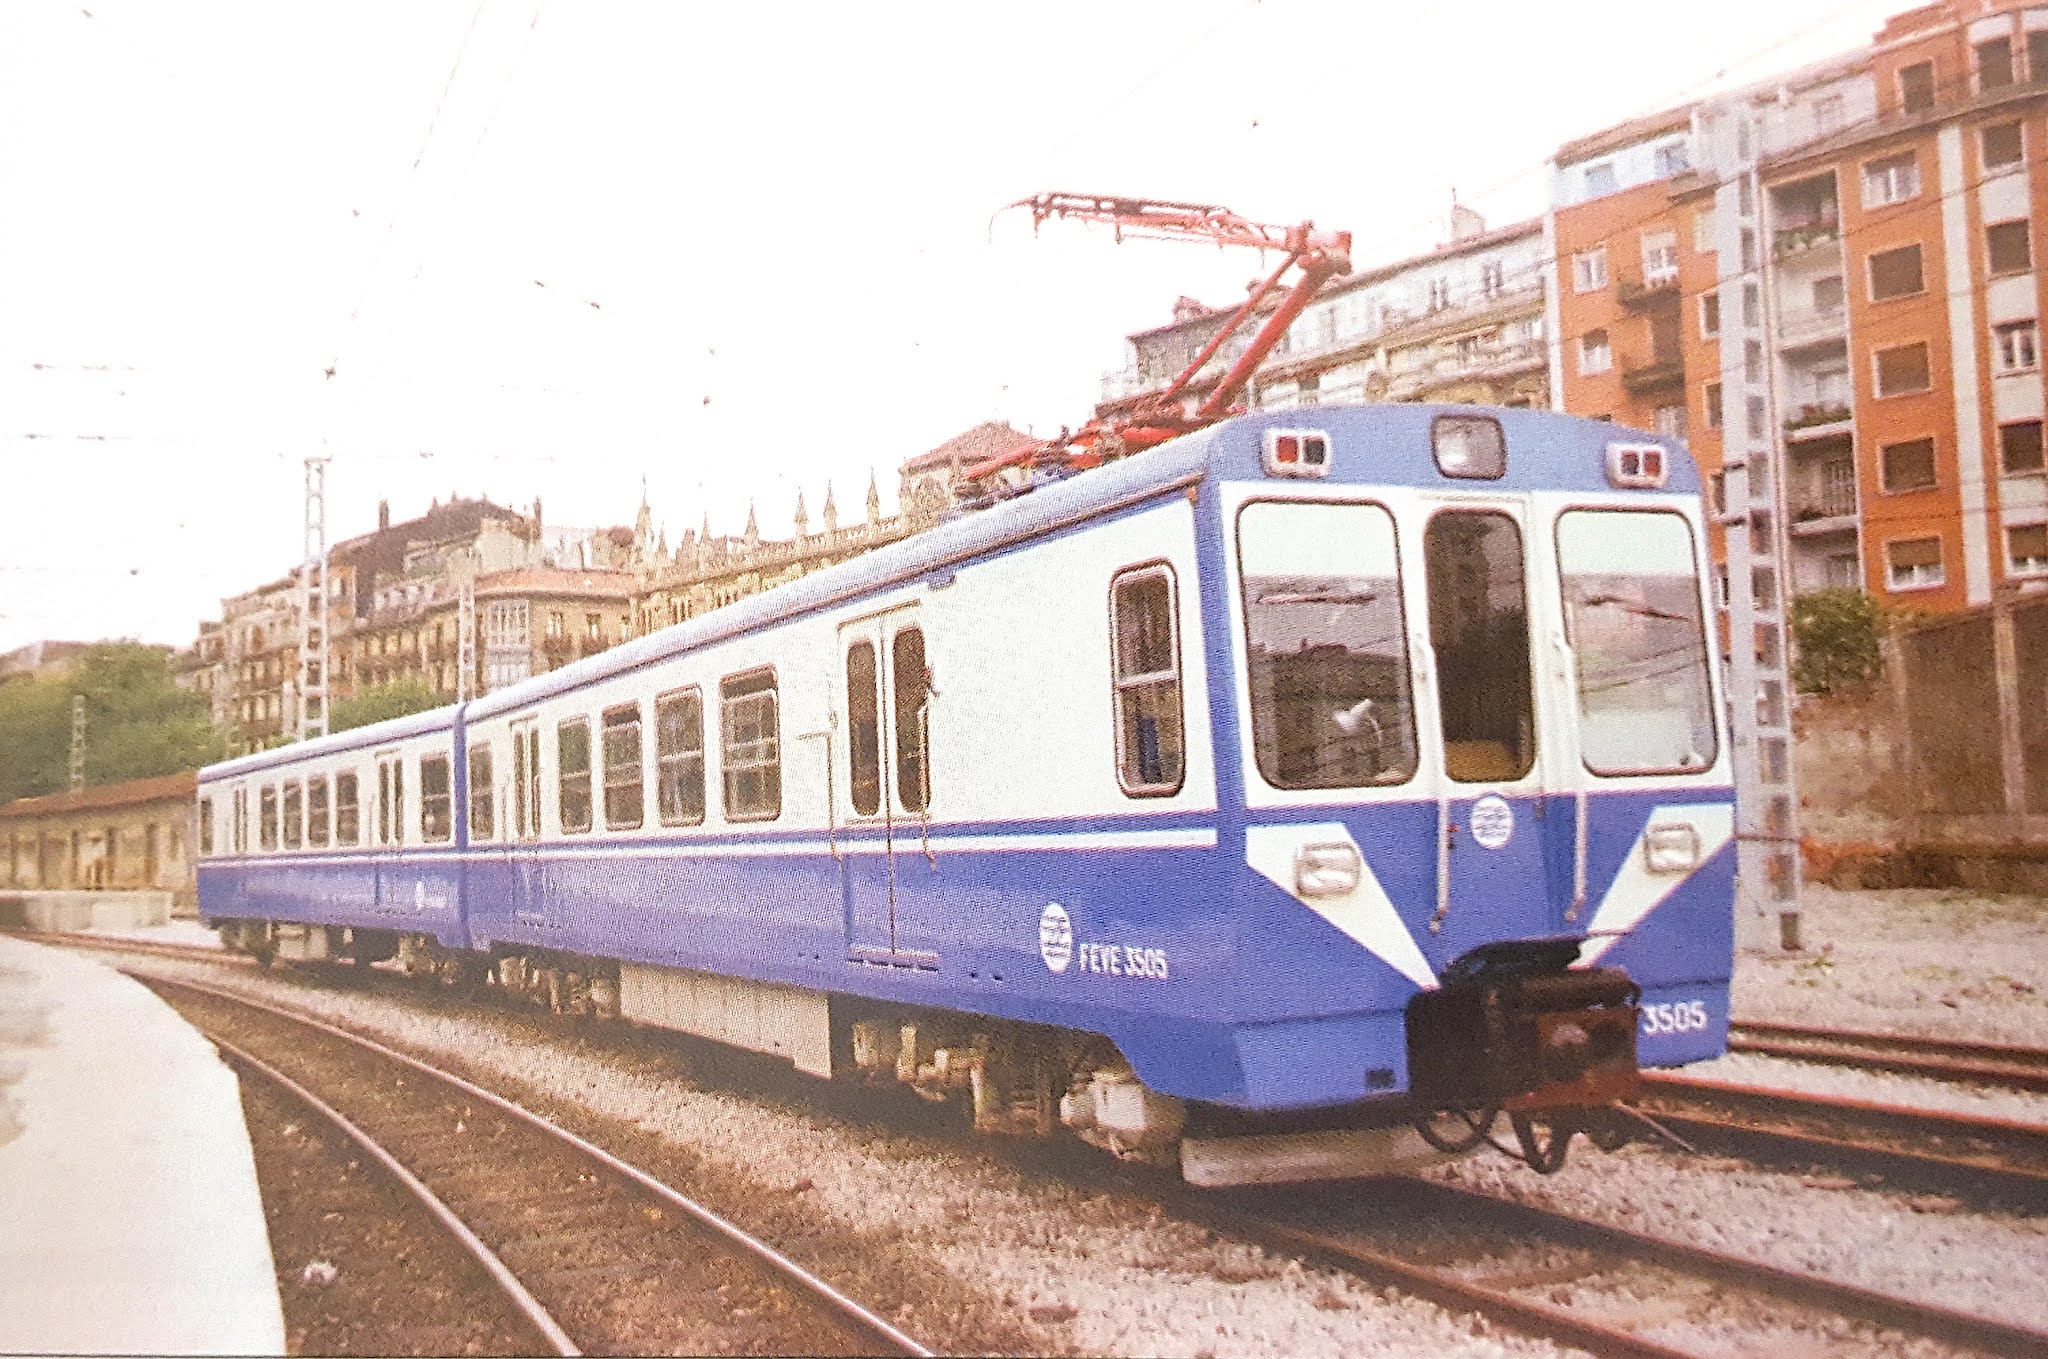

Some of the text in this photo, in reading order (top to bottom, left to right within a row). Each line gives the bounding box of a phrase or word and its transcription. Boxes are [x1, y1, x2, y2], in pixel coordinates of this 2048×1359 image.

[1079, 943, 1169, 979] FEVE 3505
[1641, 1000, 1708, 1034] 3505
